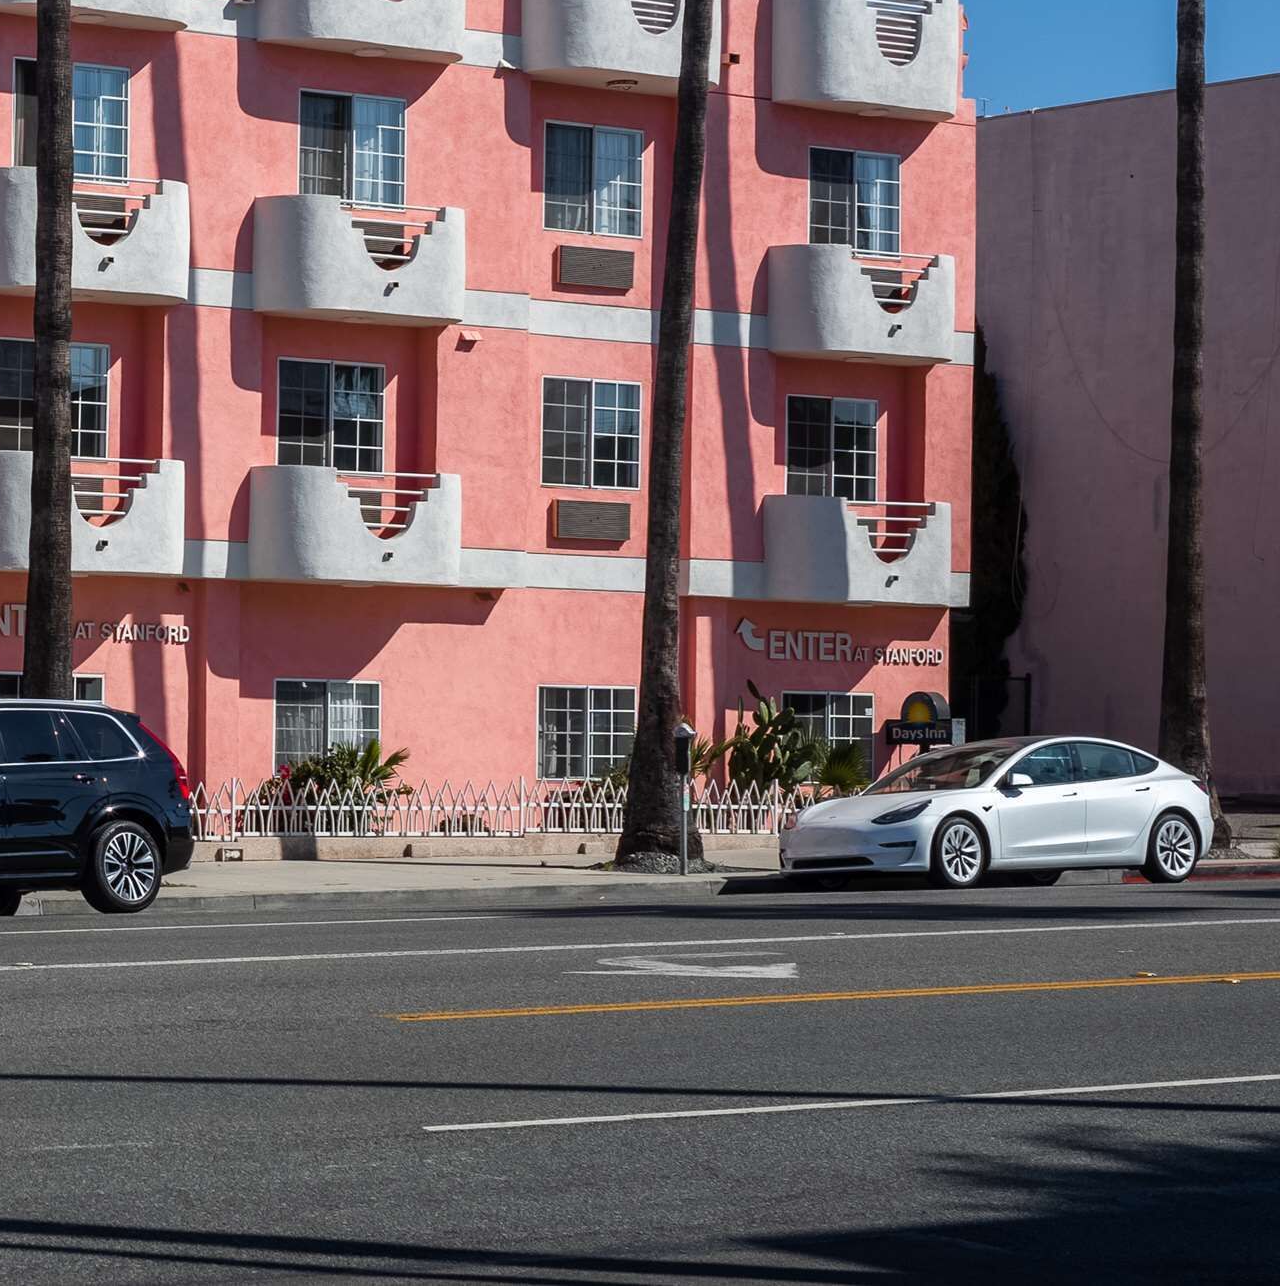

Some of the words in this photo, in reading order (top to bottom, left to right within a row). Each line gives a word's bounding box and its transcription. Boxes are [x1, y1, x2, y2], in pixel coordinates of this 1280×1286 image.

[74, 622, 96, 640] AT
[100, 622, 190, 644] STANFORD
[769, 630, 852, 662] ENTER
[854, 646, 870, 663] AT
[874, 647, 944, 664] STANFORD
[892, 727, 924, 741] Days
[925, 727, 947, 740] Inn
